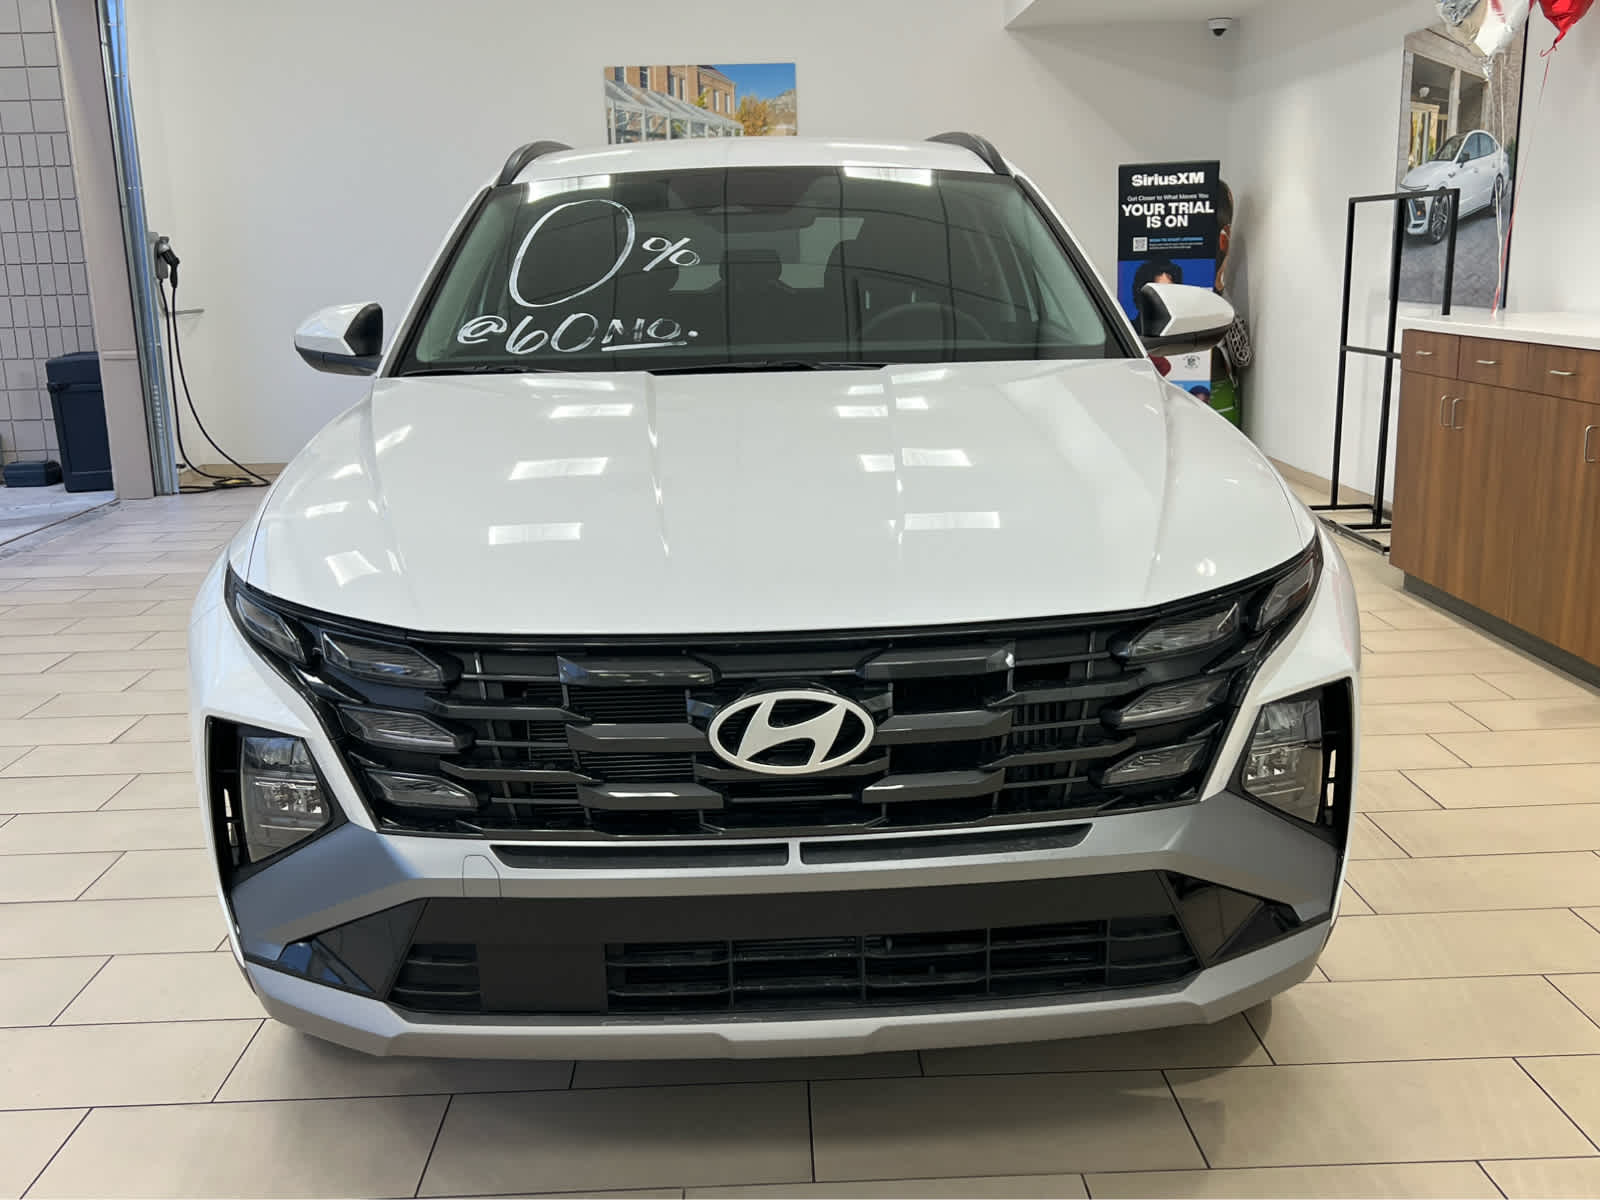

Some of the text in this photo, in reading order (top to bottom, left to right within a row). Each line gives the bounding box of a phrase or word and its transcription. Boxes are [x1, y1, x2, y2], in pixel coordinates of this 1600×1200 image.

[1131, 171, 1205, 187] SiriusXM
[1121, 200, 1215, 217] YOUR TRIAL
[1146, 214, 1189, 228] IS ON
